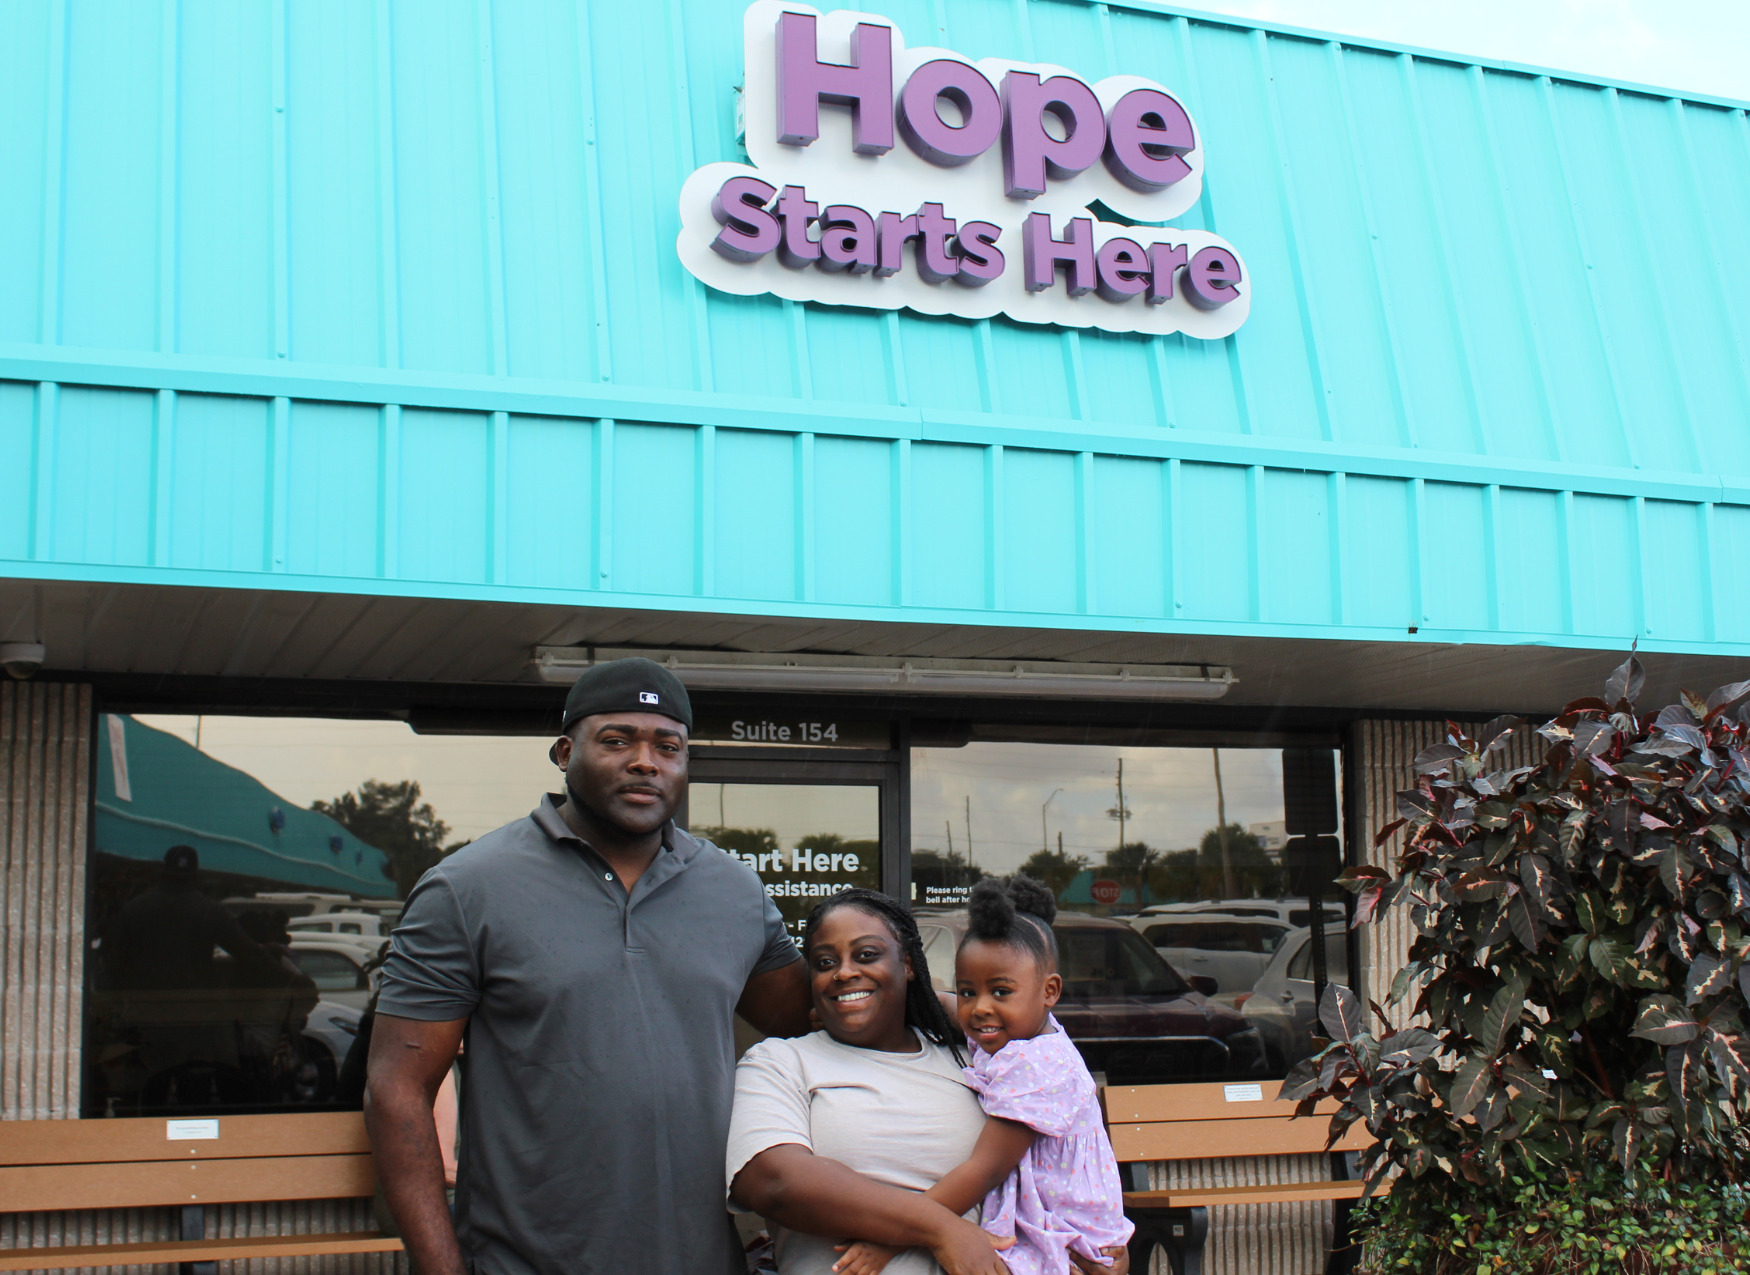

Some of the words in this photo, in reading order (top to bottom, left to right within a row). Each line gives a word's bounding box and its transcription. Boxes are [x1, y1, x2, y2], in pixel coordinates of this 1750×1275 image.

[776, 11, 1196, 200] Hope
[709, 176, 1006, 288] Starts
[1022, 212, 1242, 310] Here
[731, 720, 791, 741] Suite
[799, 722, 838, 742] 154
[718, 848, 783, 872] tart
[792, 848, 859, 872] Here
[765, 880, 853, 897] ssistanc
[926, 886, 951, 894] Please
[952, 886, 968, 895] ring
[926, 896, 941, 904] bell
[941, 896, 960, 904] after
